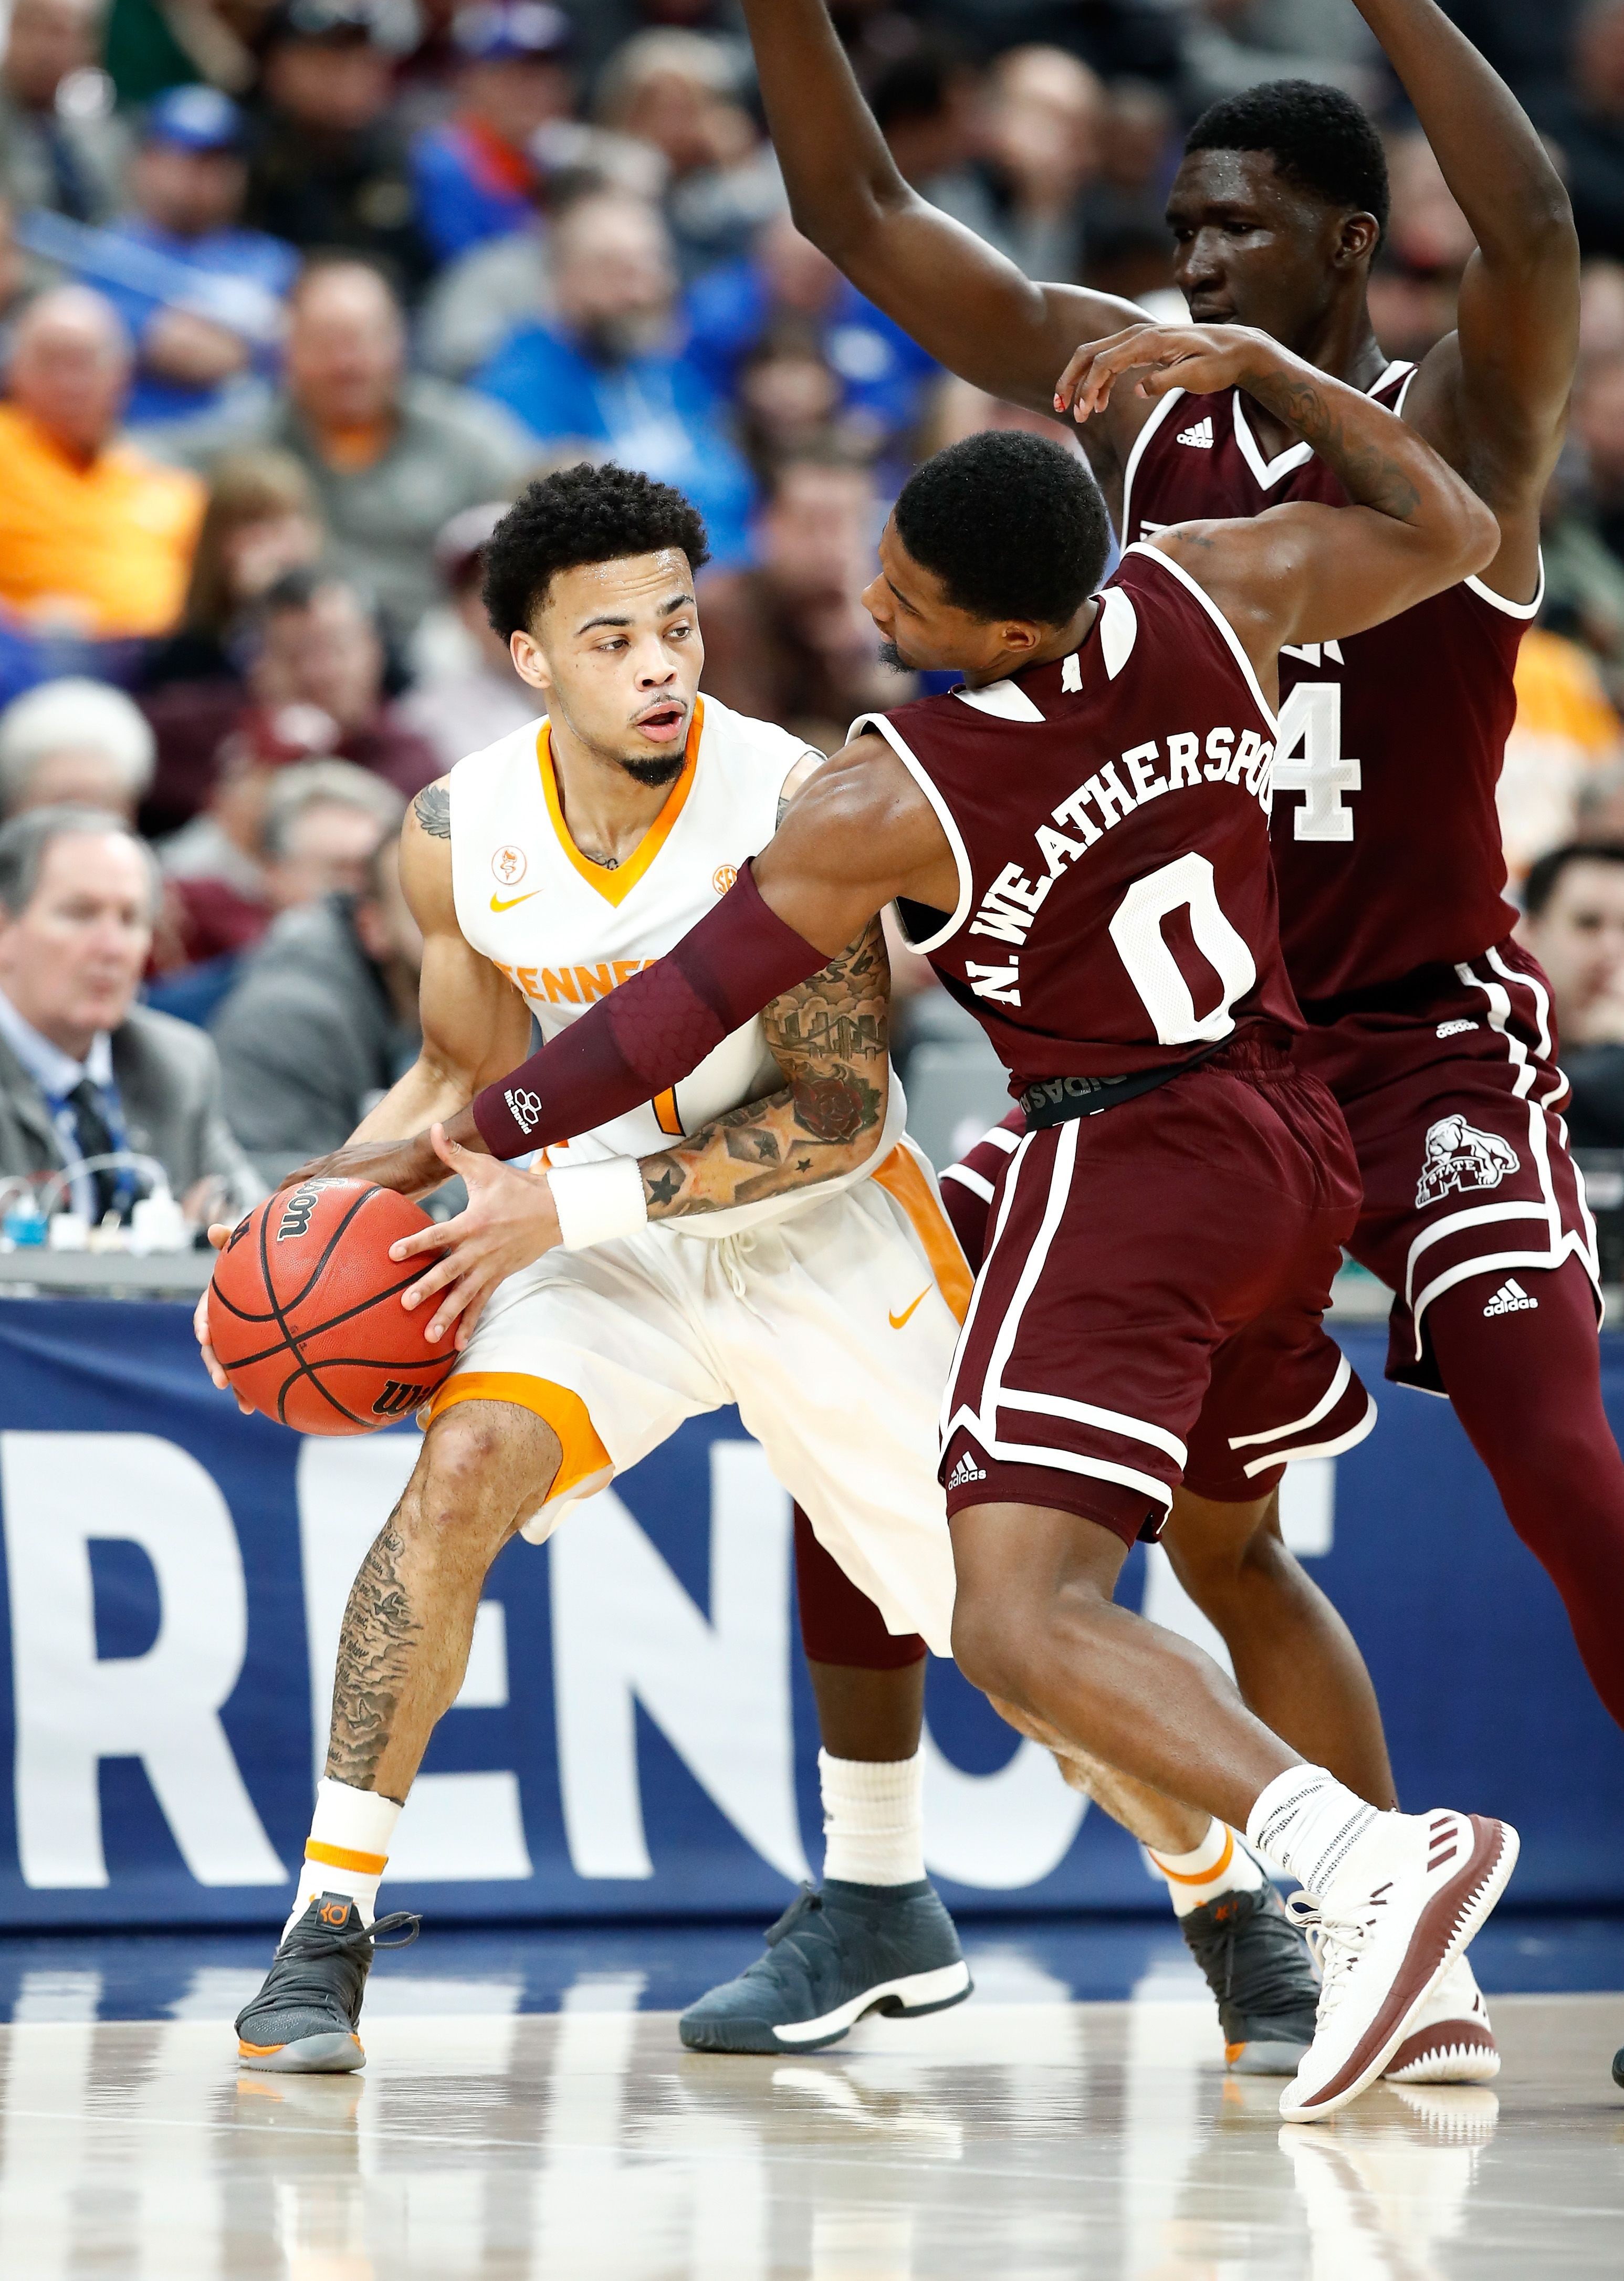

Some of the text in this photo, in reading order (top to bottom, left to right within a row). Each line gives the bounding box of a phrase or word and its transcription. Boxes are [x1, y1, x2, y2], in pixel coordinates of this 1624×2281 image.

[969, 727, 1274, 946] WEATHERSPOO
[1108, 851, 1257, 1045] 0
[1483, 1297, 1538, 1317] adidas
[948, 1469, 987, 1491] adidas
